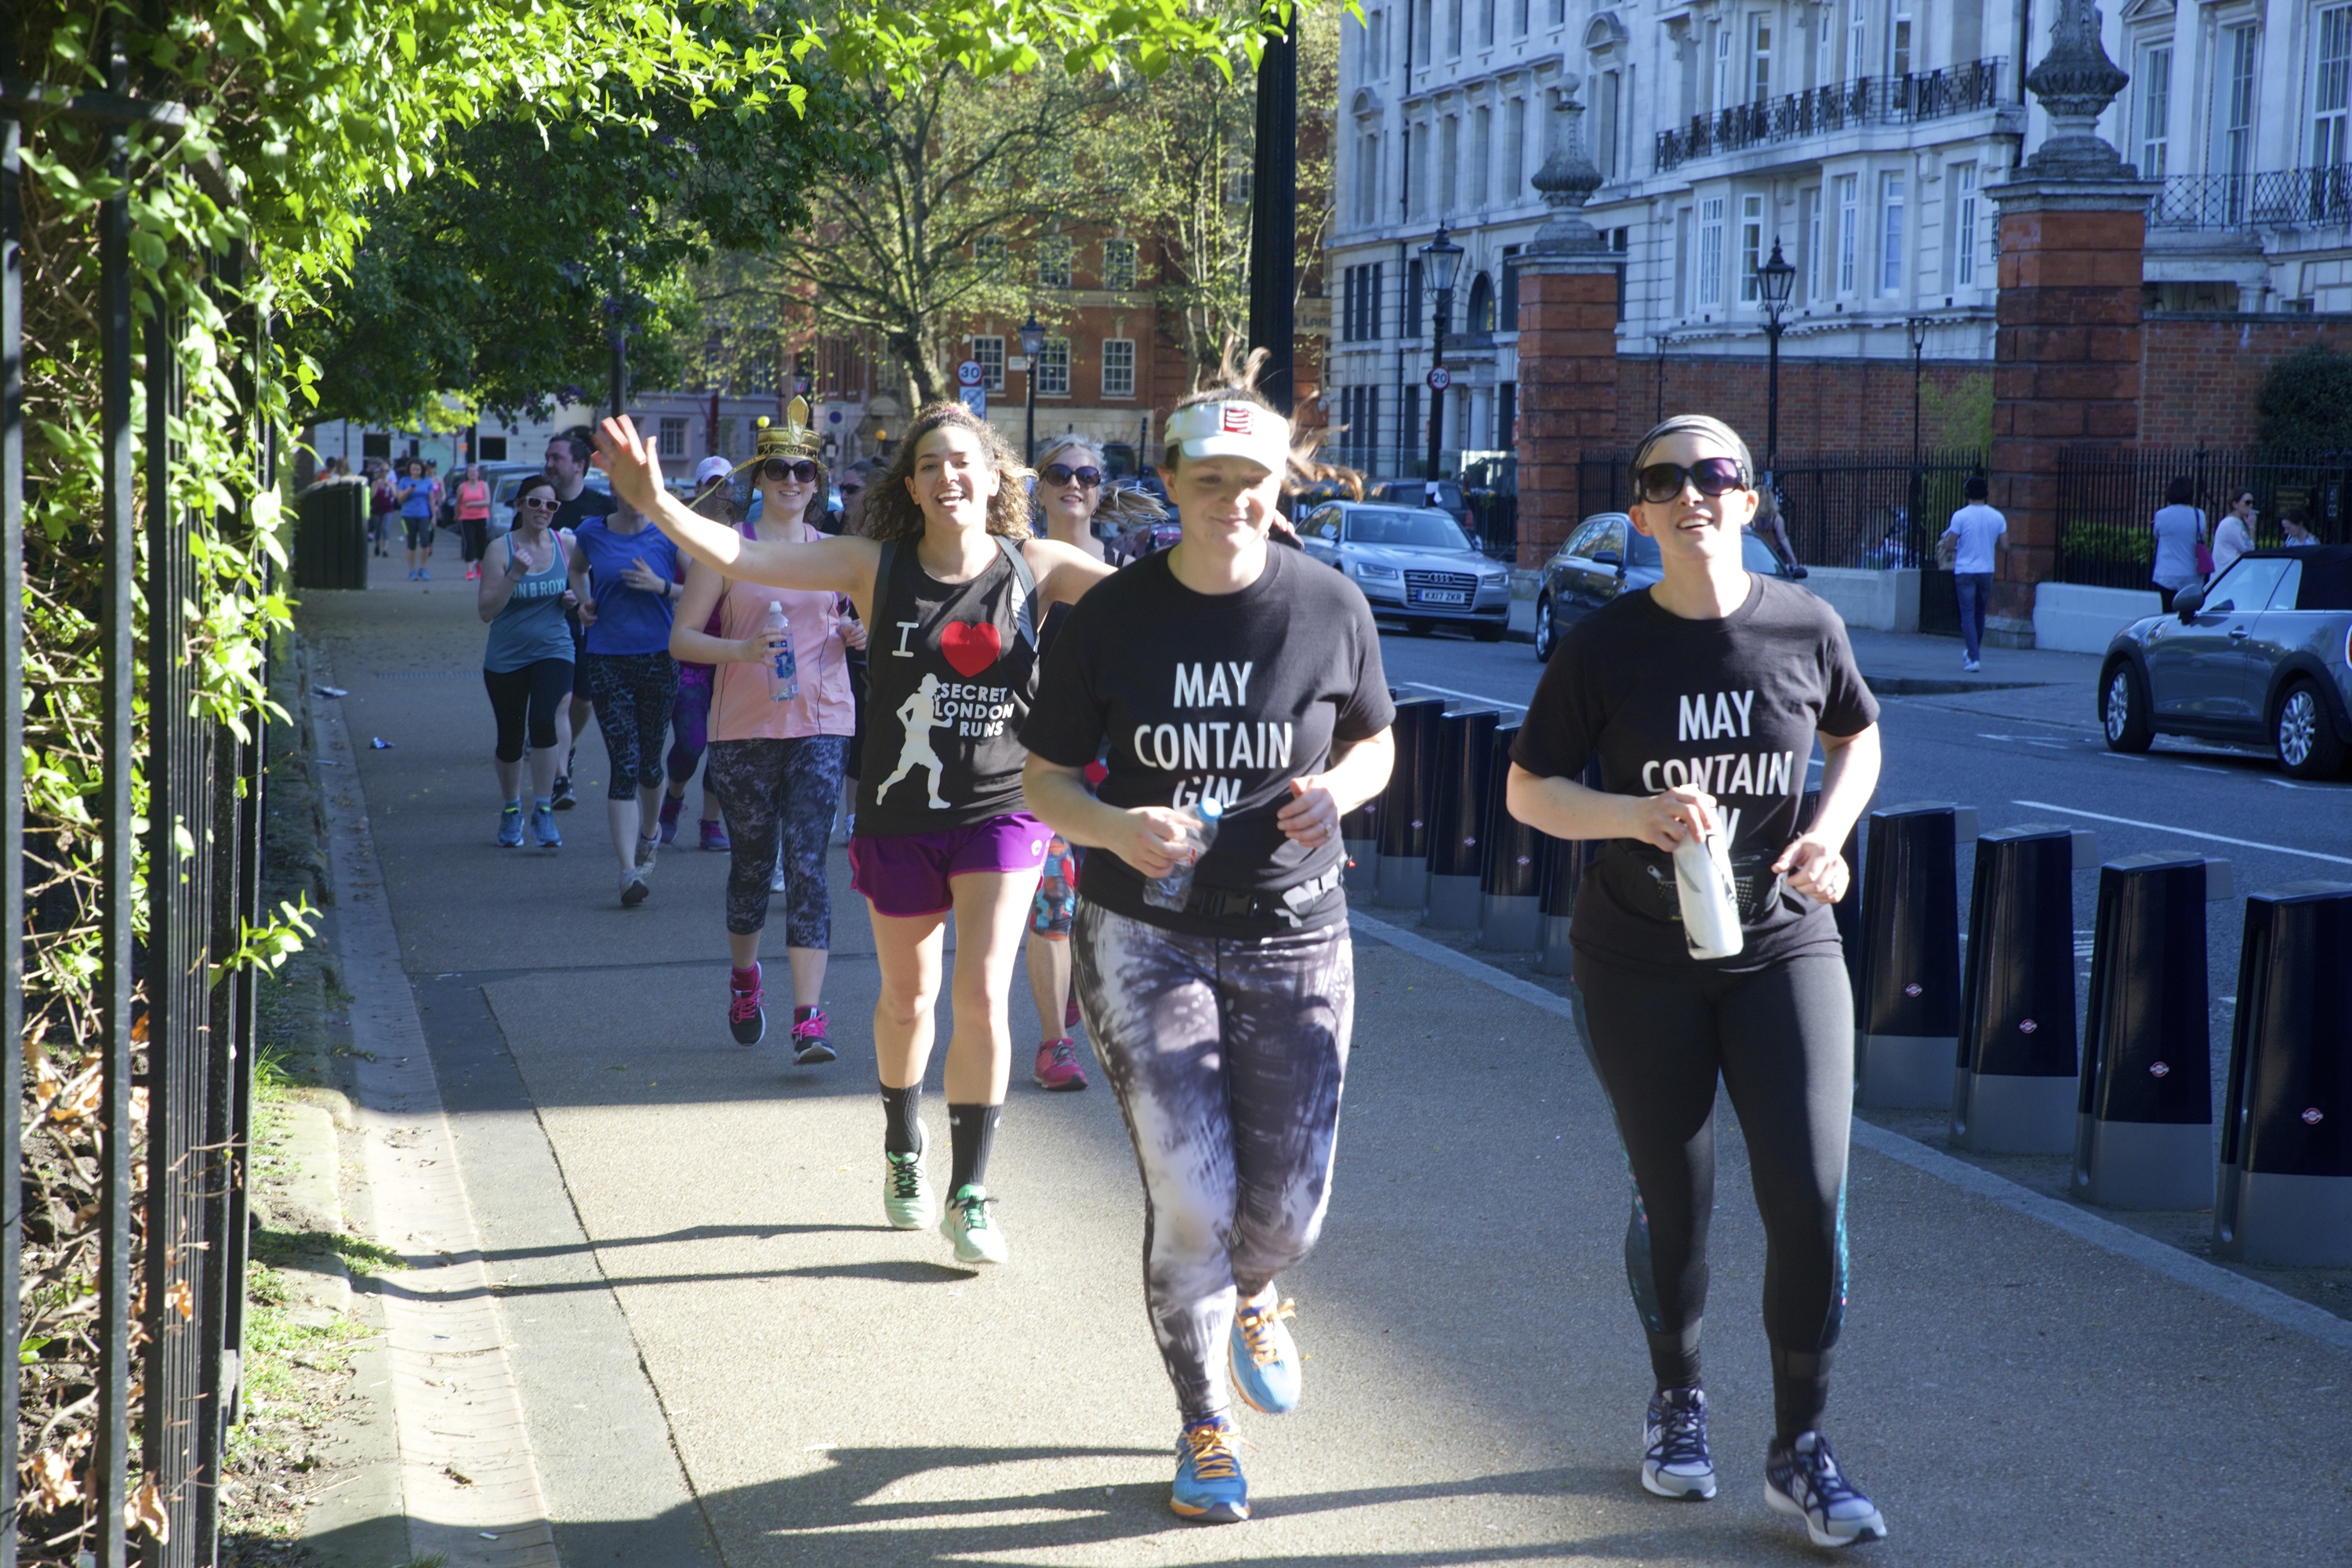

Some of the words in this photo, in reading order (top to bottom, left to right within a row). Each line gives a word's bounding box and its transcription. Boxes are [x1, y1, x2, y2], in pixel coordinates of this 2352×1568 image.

[960, 366, 980, 379] 30
[1433, 372, 1447, 383] 20
[1425, 591, 1443, 601] KX17
[1445, 592, 1461, 601] ZKR
[892, 622, 919, 657] I
[940, 682, 1007, 702] SECRET
[1174, 661, 1253, 708] MAY
[935, 701, 1014, 720] LONDON
[1679, 690, 1755, 742] MAY
[959, 720, 1004, 738] RUNS
[1134, 721, 1293, 771] CONTAIN
[1642, 750, 1794, 797] CONTAIN
[1172, 774, 1243, 811] GIN
